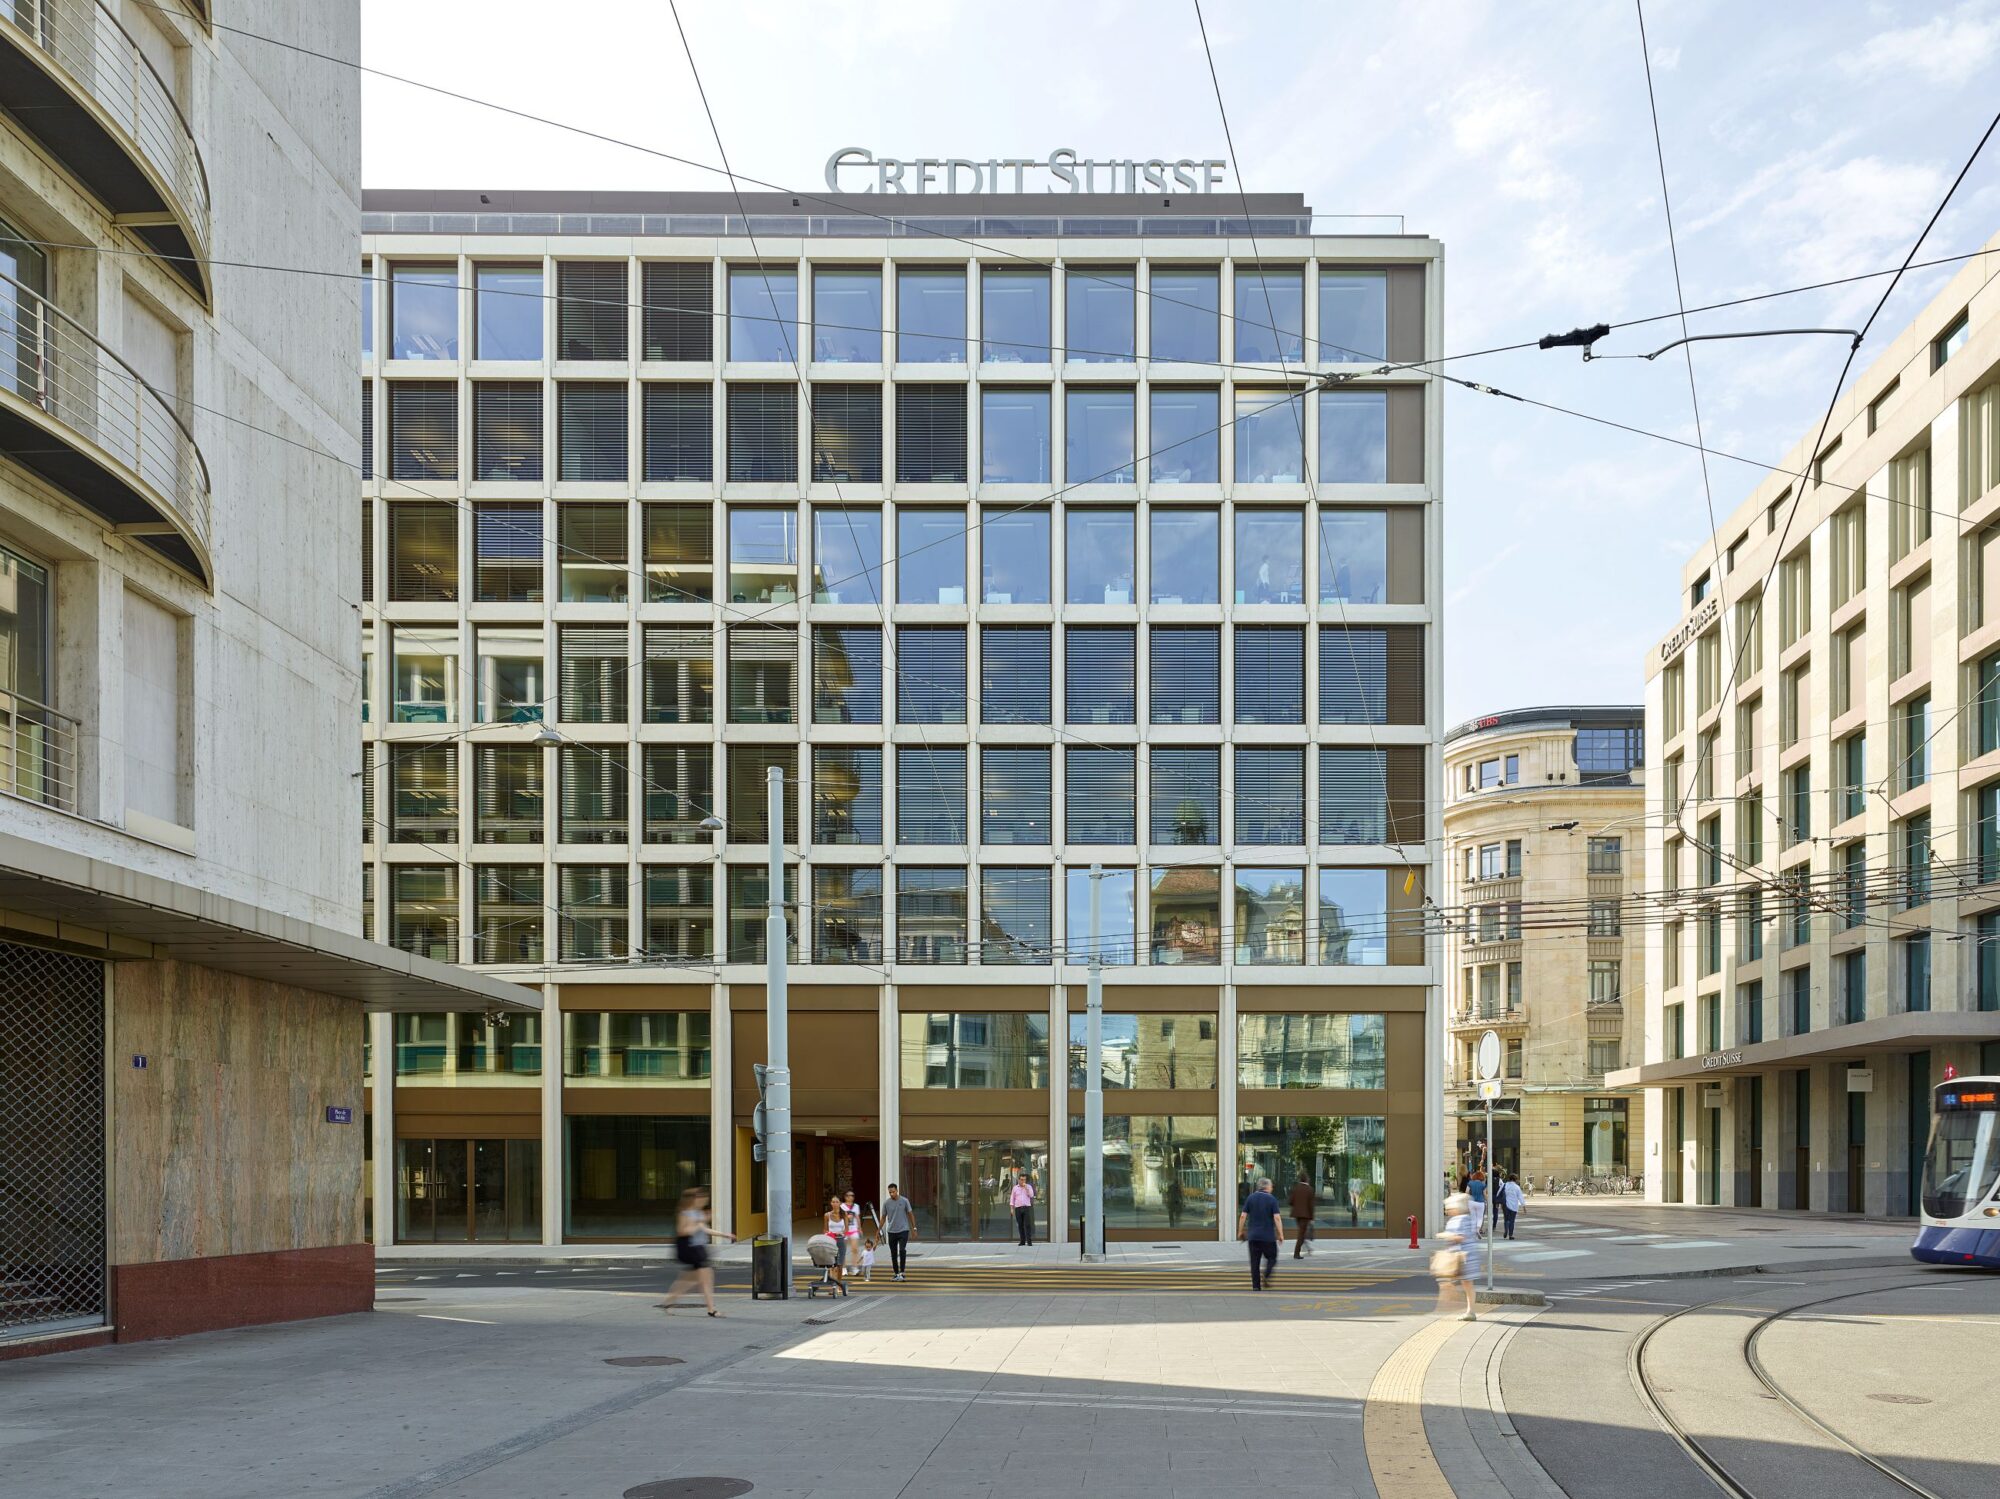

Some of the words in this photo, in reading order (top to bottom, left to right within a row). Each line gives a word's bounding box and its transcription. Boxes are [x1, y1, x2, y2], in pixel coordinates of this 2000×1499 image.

[825, 147, 1036, 194] CREDIT
[1047, 148, 1227, 194] SUISSE
[1479, 717, 1499, 729] UBS
[1701, 1055, 1723, 1069] CREDIT
[1722, 1051, 1743, 1065] SUISSE
